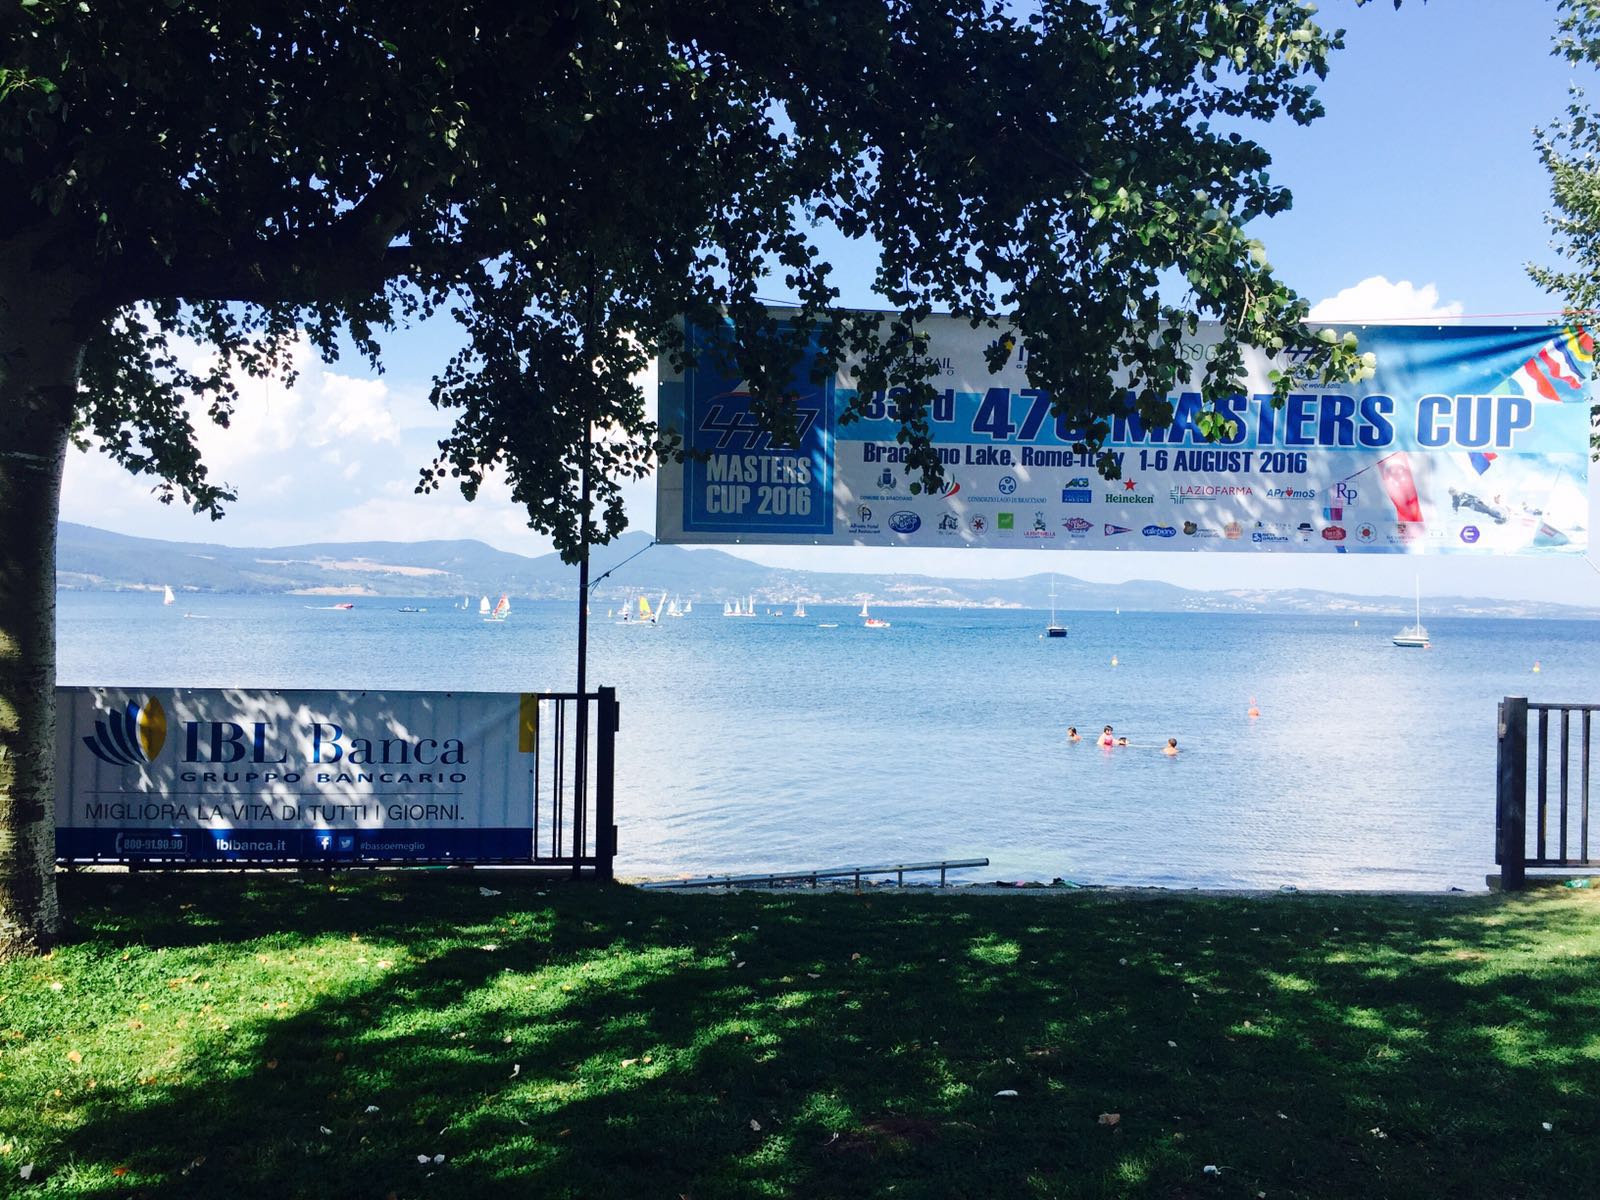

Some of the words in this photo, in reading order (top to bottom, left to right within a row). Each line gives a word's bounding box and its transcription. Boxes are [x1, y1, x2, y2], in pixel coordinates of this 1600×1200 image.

[1112, 391, 1395, 448] MASTERS
[1416, 395, 1533, 449] CUP
[706, 454, 812, 485] MASTERS
[965, 445, 1016, 468] Lake,
[1139, 449, 1169, 471] 1-6
[1173, 450, 1254, 473] AUGUST
[1260, 451, 1308, 474] 2016
[706, 485, 751, 514] CUP
[757, 486, 812, 516] 2016
[1105, 493, 1154, 504] Heineken
[1180, 485, 1253, 496] LAZIOFARMA
[181, 720, 288, 764] IBL
[306, 722, 469, 766] Banca
[180, 772, 301, 783] GRUPPO
[317, 773, 467, 784] BANCARIO
[85, 803, 190, 821] MIGLIORA
[197, 804, 225, 821] LA
[232, 804, 275, 821] VITA
[283, 804, 301, 821] DI
[308, 804, 367, 821] TUTTI
[375, 804, 380, 821] I
[388, 804, 465, 822] GIORNI.
[360, 841, 426, 852] #bassoemeglio
